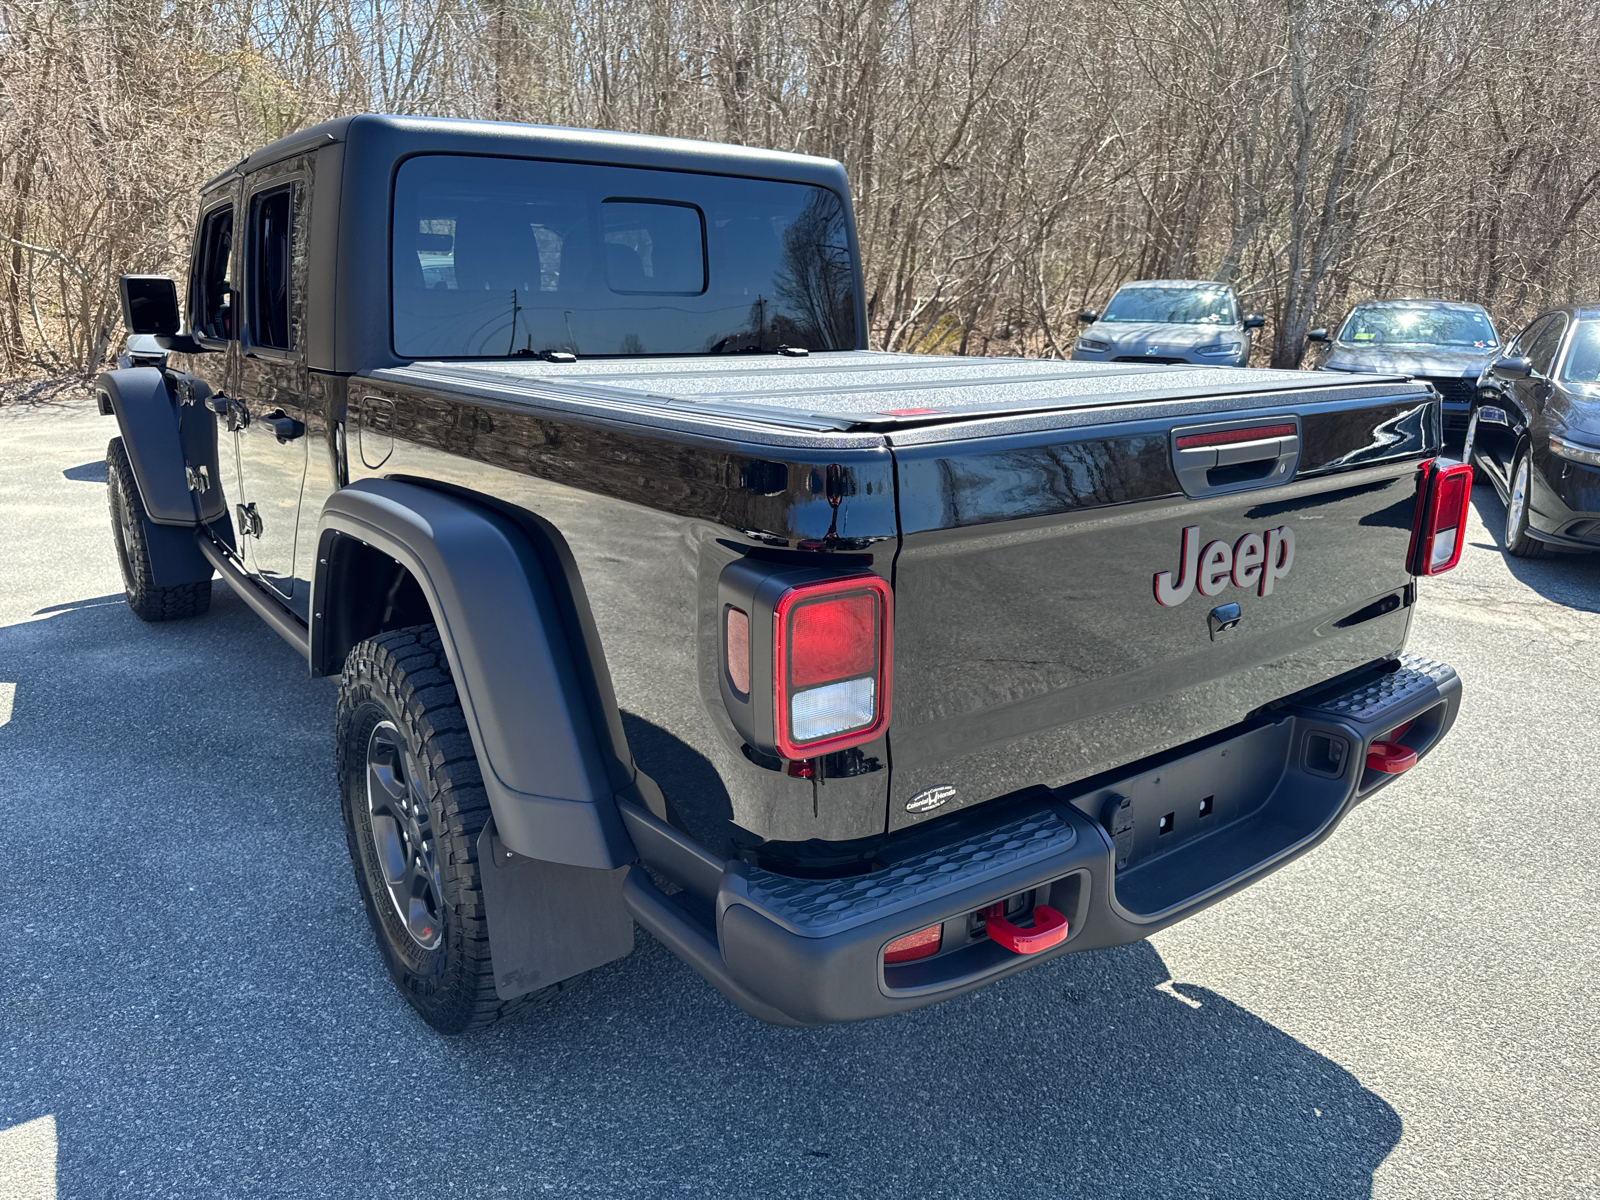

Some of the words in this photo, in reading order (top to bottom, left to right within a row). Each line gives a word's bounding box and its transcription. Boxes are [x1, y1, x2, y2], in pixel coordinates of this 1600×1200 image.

[1154, 525, 1295, 607] Jeep
[907, 798, 928, 810] Colonial
[937, 789, 956, 799] Honda
